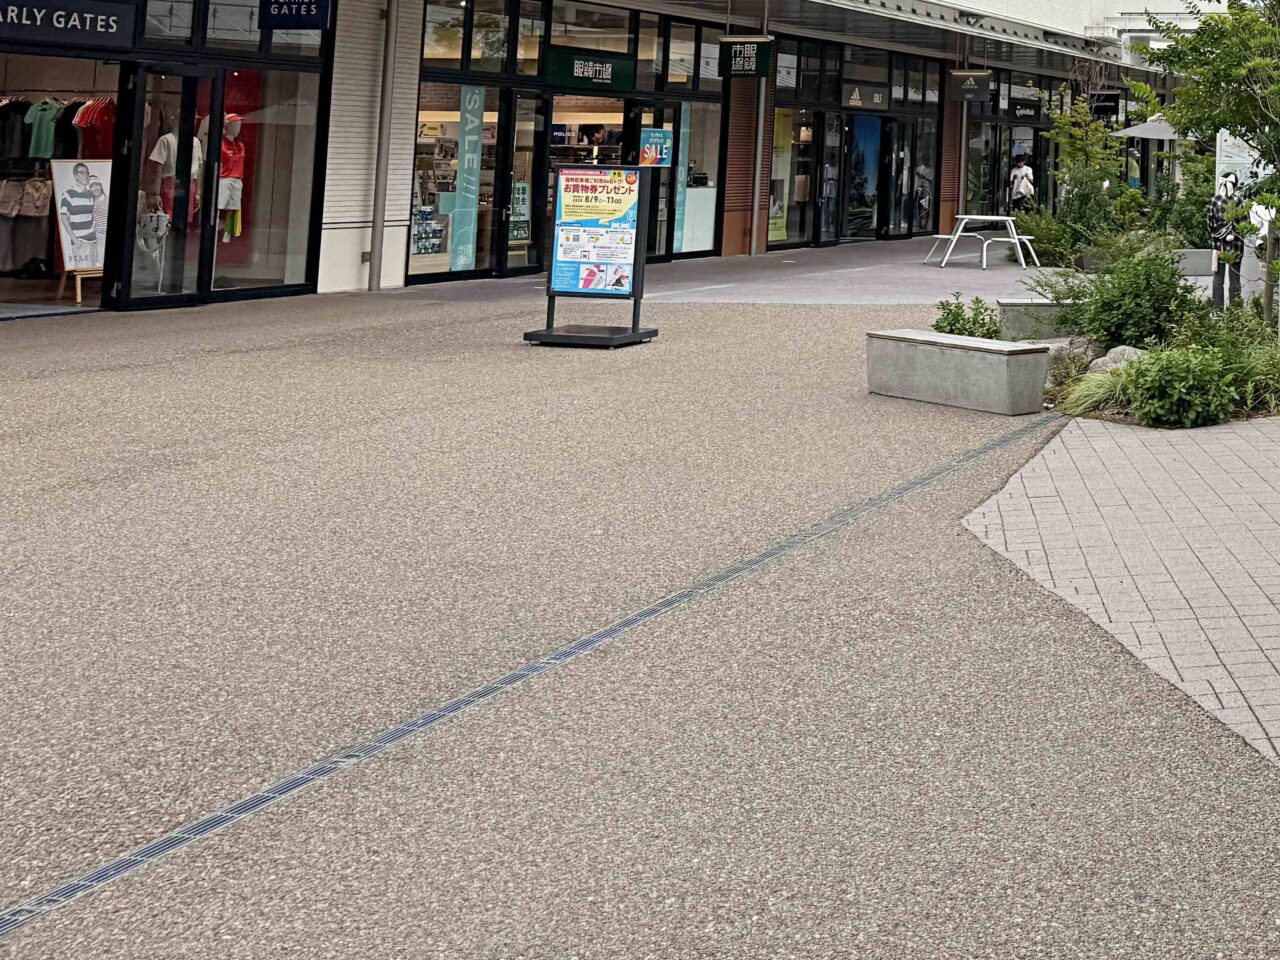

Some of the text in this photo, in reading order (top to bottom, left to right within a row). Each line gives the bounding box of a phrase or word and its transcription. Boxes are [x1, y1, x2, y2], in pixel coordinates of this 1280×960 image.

[270, 4, 317, 15] GATES
[0, 5, 118, 33] RLY GATES
[573, 60, 612, 79] 眼鏡市場
[644, 143, 668, 159] SALE
